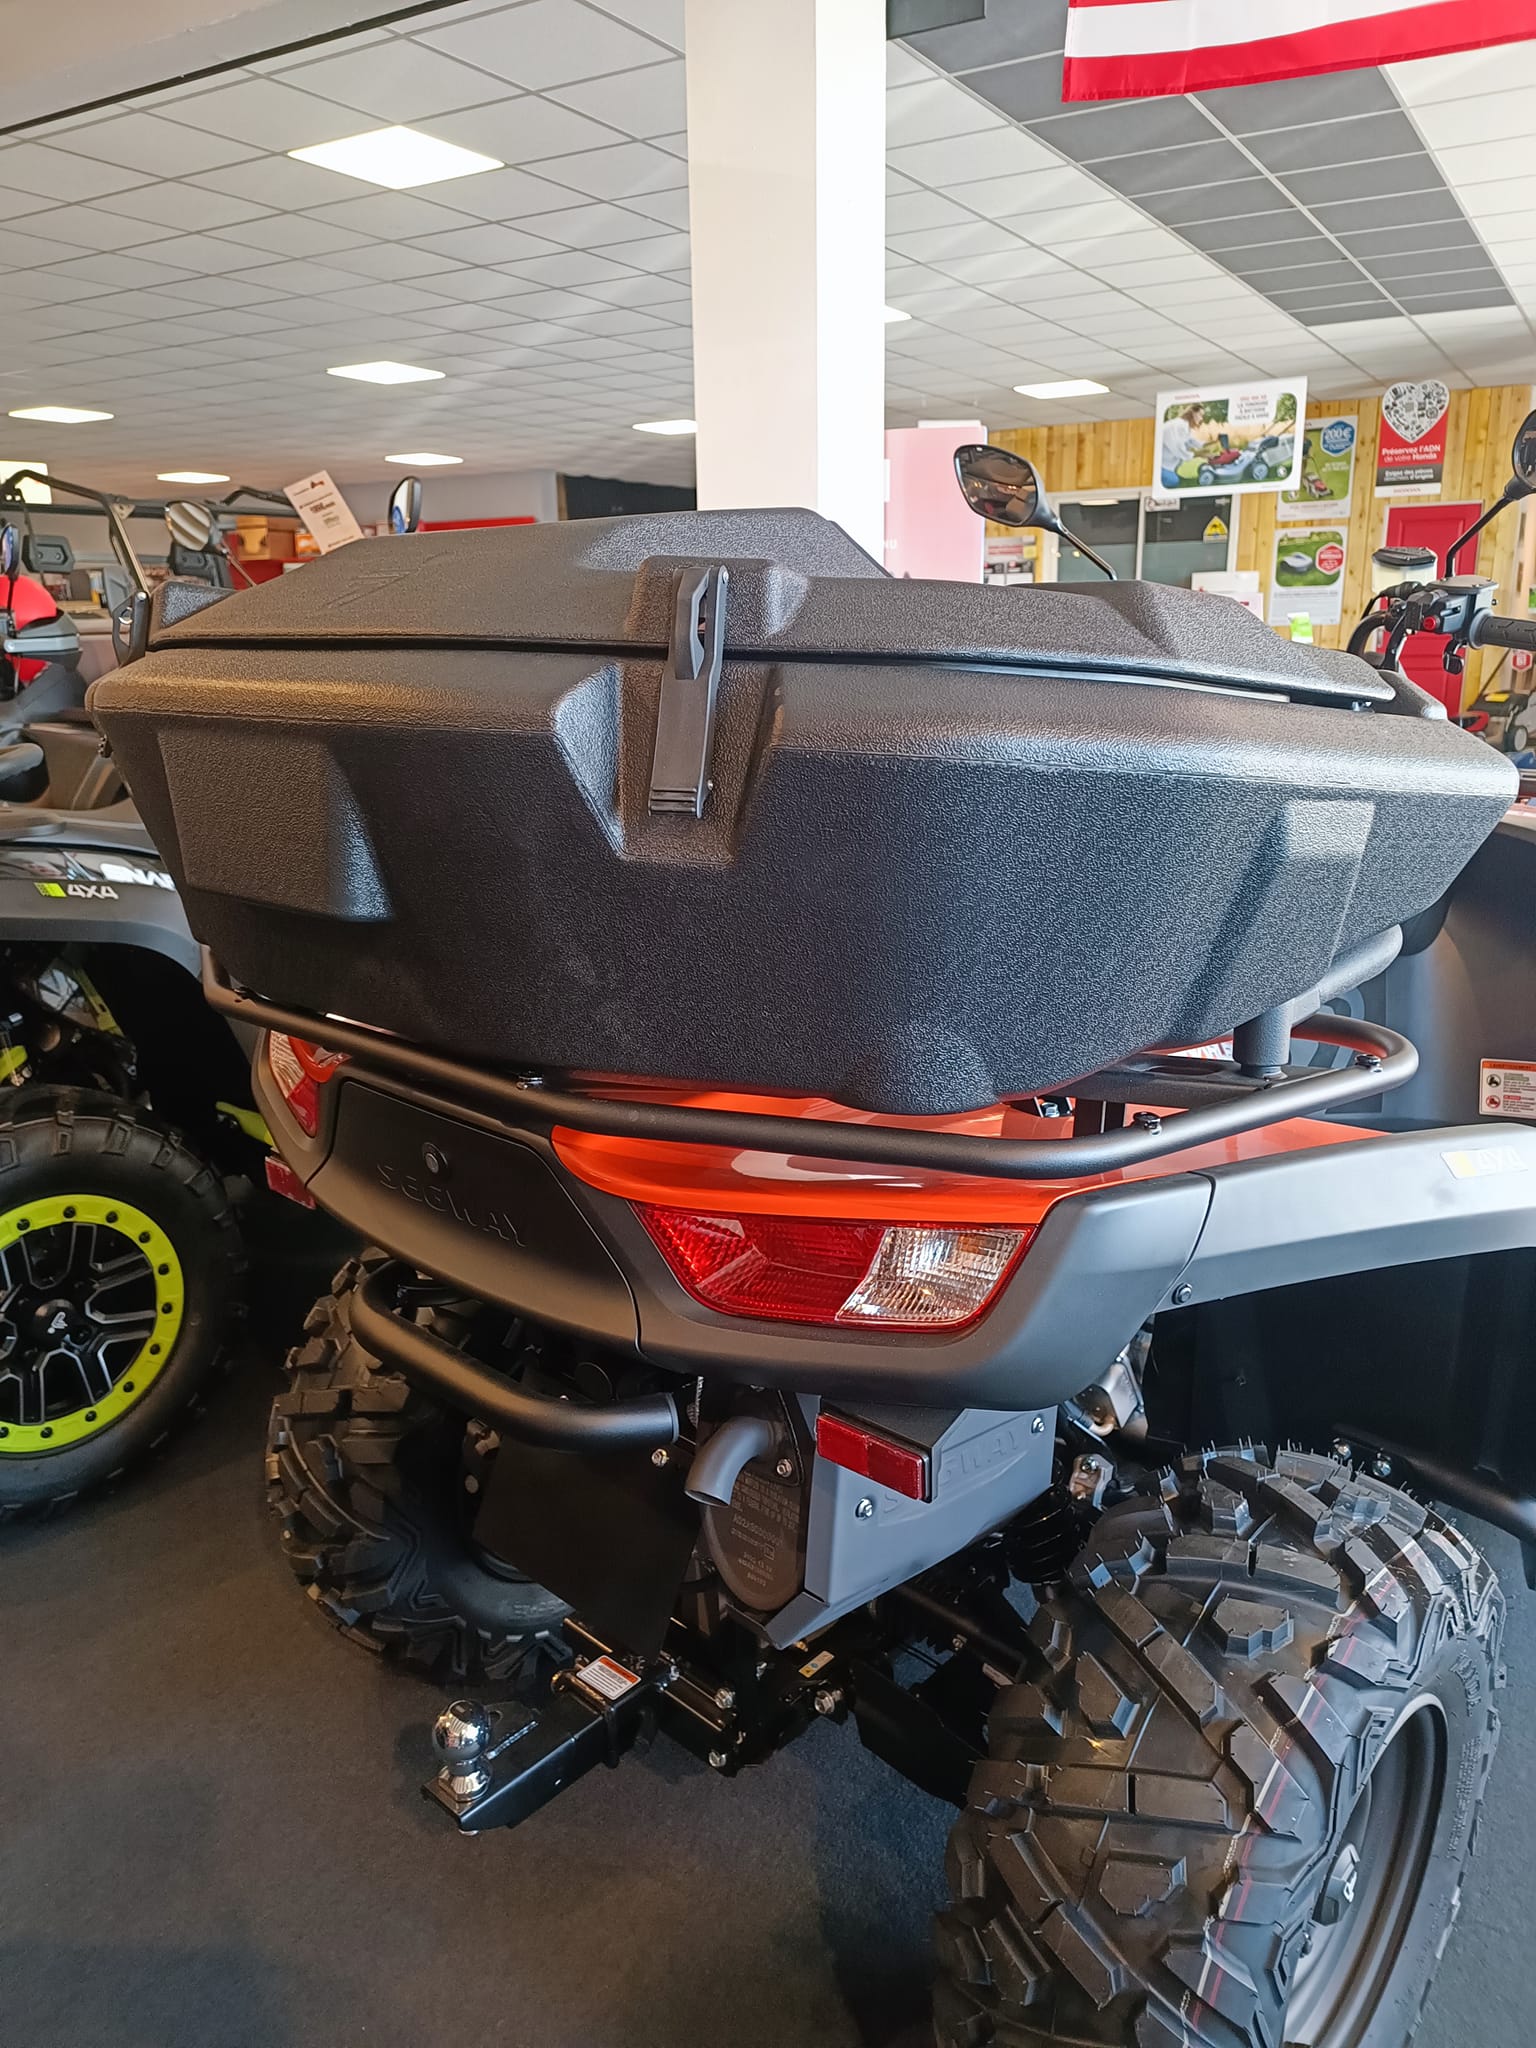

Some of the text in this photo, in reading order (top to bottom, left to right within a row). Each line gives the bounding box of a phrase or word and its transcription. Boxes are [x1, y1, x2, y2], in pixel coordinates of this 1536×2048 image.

[1382, 444, 1440, 455] Préservez l'ADN
[1412, 453, 1437, 461] Honda
[66, 883, 120, 900] 4X4
[376, 1162, 528, 1249] SEGWAY
